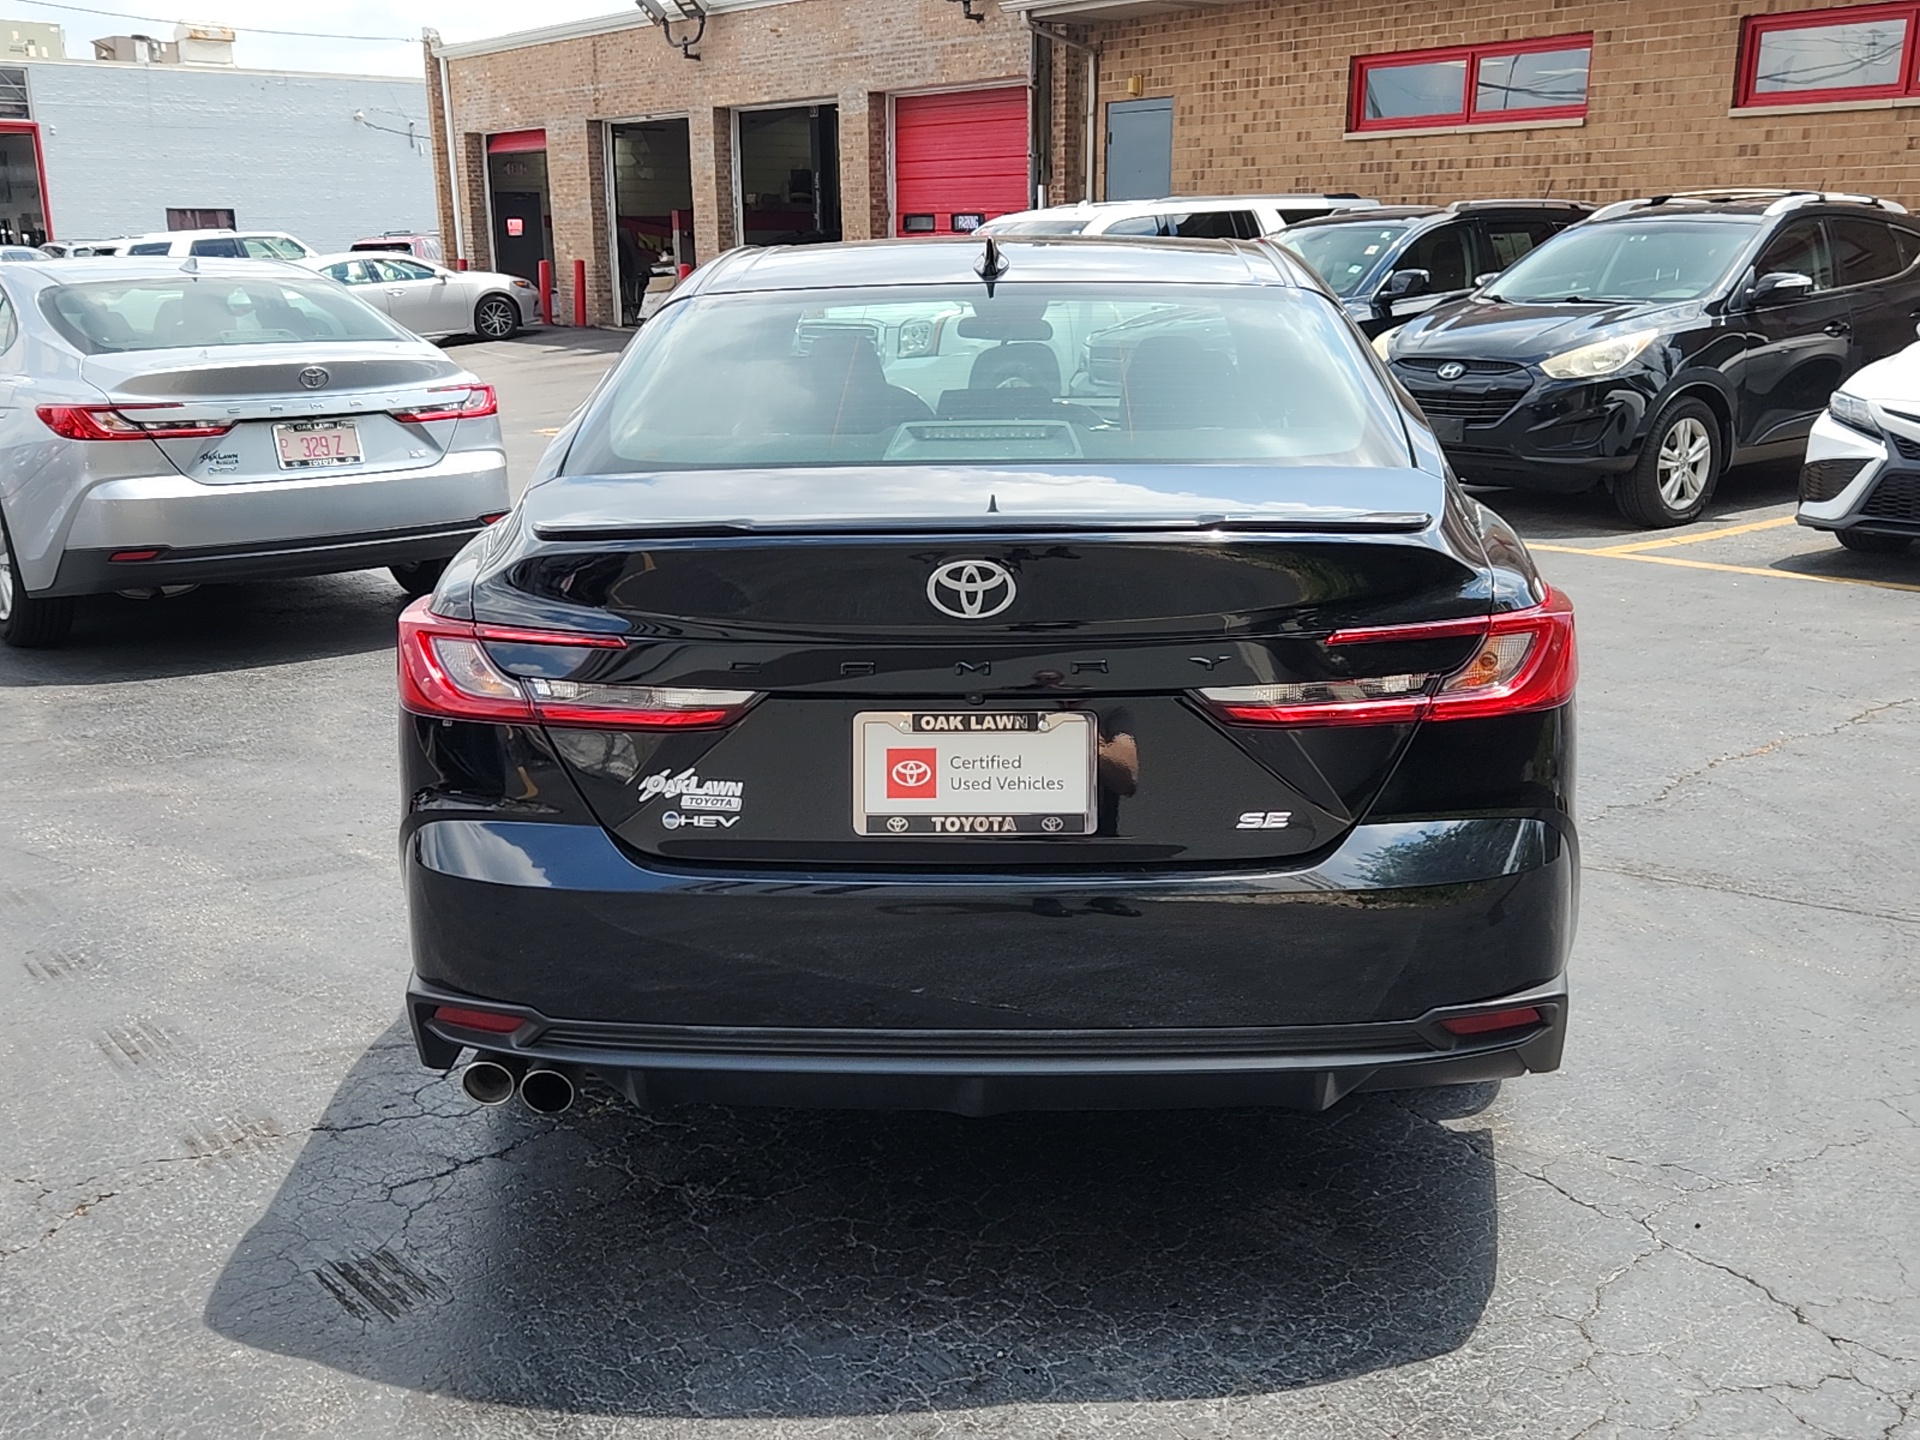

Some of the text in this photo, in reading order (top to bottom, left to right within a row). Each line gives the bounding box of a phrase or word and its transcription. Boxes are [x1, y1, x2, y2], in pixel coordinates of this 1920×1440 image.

[300, 434, 345, 458] 329 Z
[307, 458, 339, 467] TOYOTA
[920, 715, 1029, 730] OAK LAWN
[949, 755, 1022, 770] Certified
[949, 776, 1064, 791] Used Vehicles
[689, 797, 732, 807] TOYOTA
[680, 814, 741, 828] HEV
[931, 816, 1017, 832] TOYOTA
[1235, 811, 1292, 829] SE
